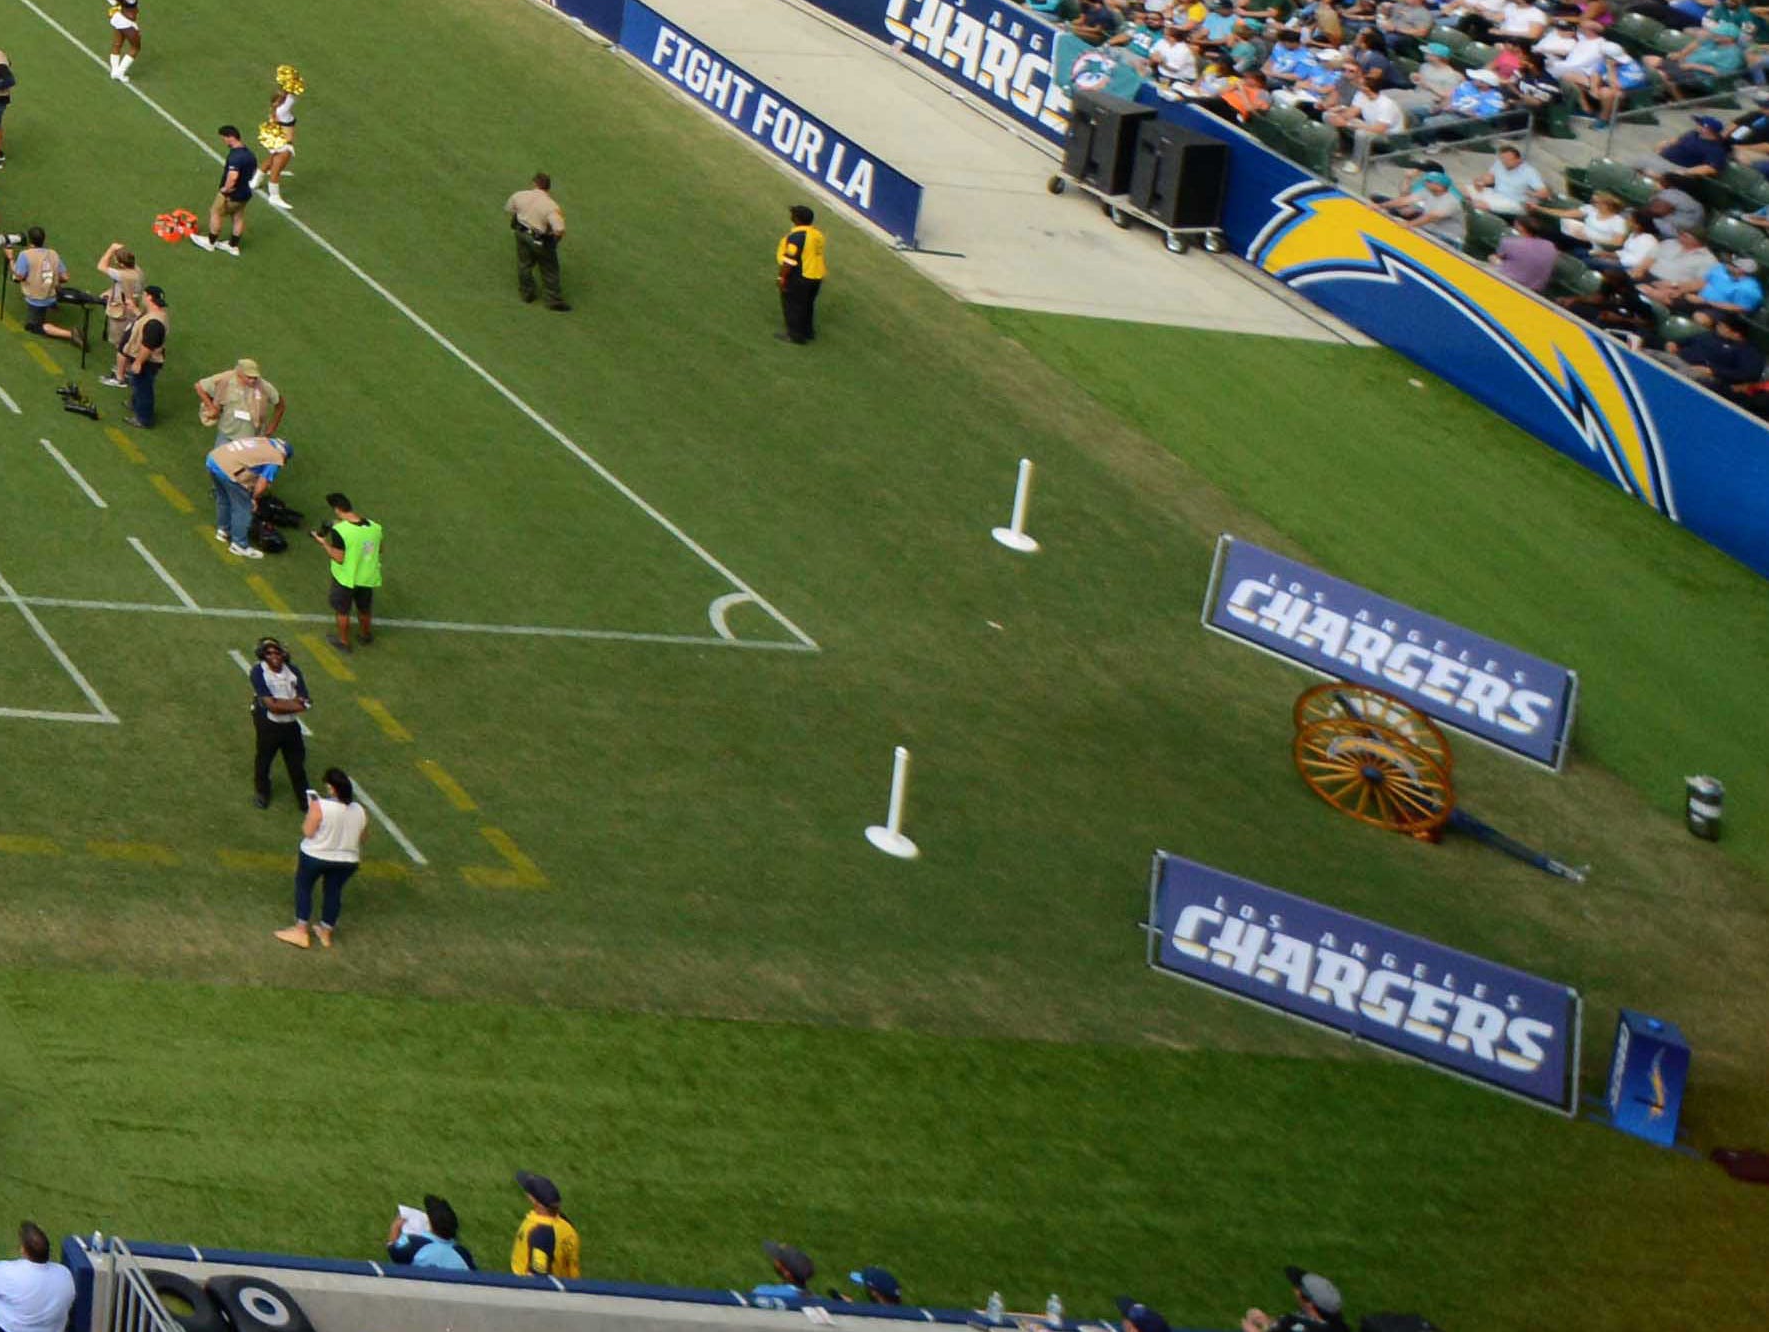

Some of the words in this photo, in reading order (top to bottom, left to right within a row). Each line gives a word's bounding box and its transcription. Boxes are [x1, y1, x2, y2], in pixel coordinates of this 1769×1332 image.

[653, 24, 753, 120] FIGHT
[753, 92, 824, 180] FOR
[826, 142, 875, 211] LA
[1226, 577, 1554, 735] CHARGERS
[1267, 572, 1325, 606] LOS
[1355, 608, 1526, 685] ANGELES
[1172, 903, 1554, 1075] CHARGERS
[1214, 893, 1281, 933] LOS
[1318, 930, 1524, 1012] ANGELES
